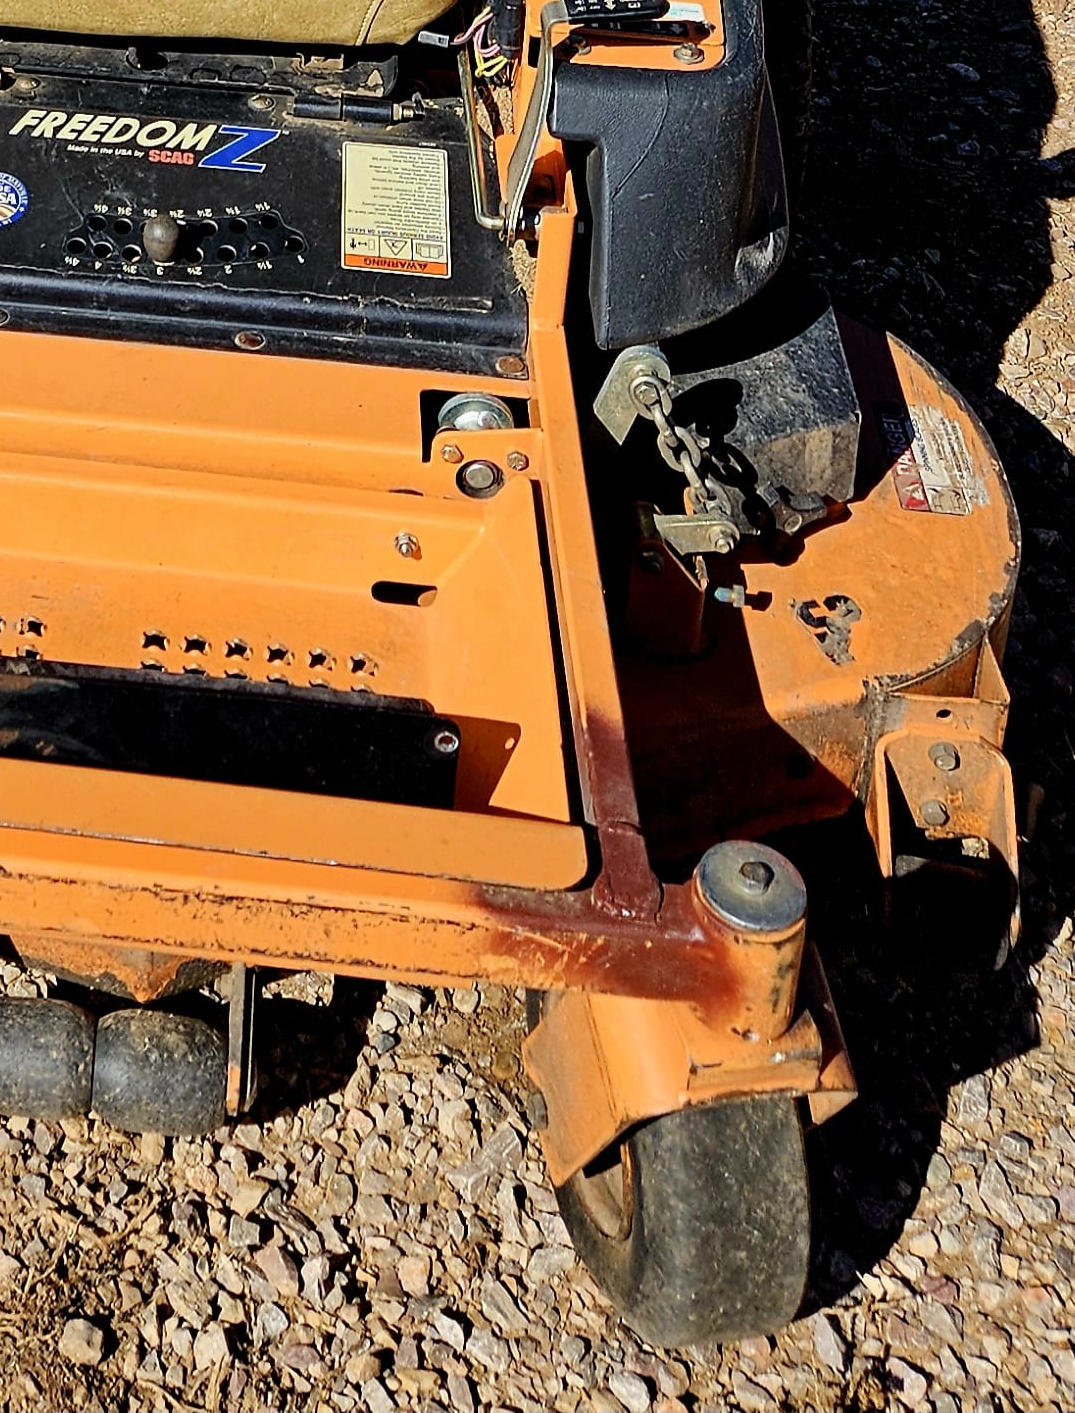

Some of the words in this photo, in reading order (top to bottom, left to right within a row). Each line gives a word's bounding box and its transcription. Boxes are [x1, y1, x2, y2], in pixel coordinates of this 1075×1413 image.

[67, 143, 89, 153] Made
[90, 145, 99, 153] in
[100, 146, 114, 155] the
[115, 147, 133, 156] USA
[134, 150, 145, 158] by
[148, 149, 195, 166] SCAG
[297, 254, 305, 264] 1
[363, 257, 416, 269] WARNING
[95, 261, 102, 270] 4
[225, 265, 232, 274] 2
[156, 267, 164, 275] 3
